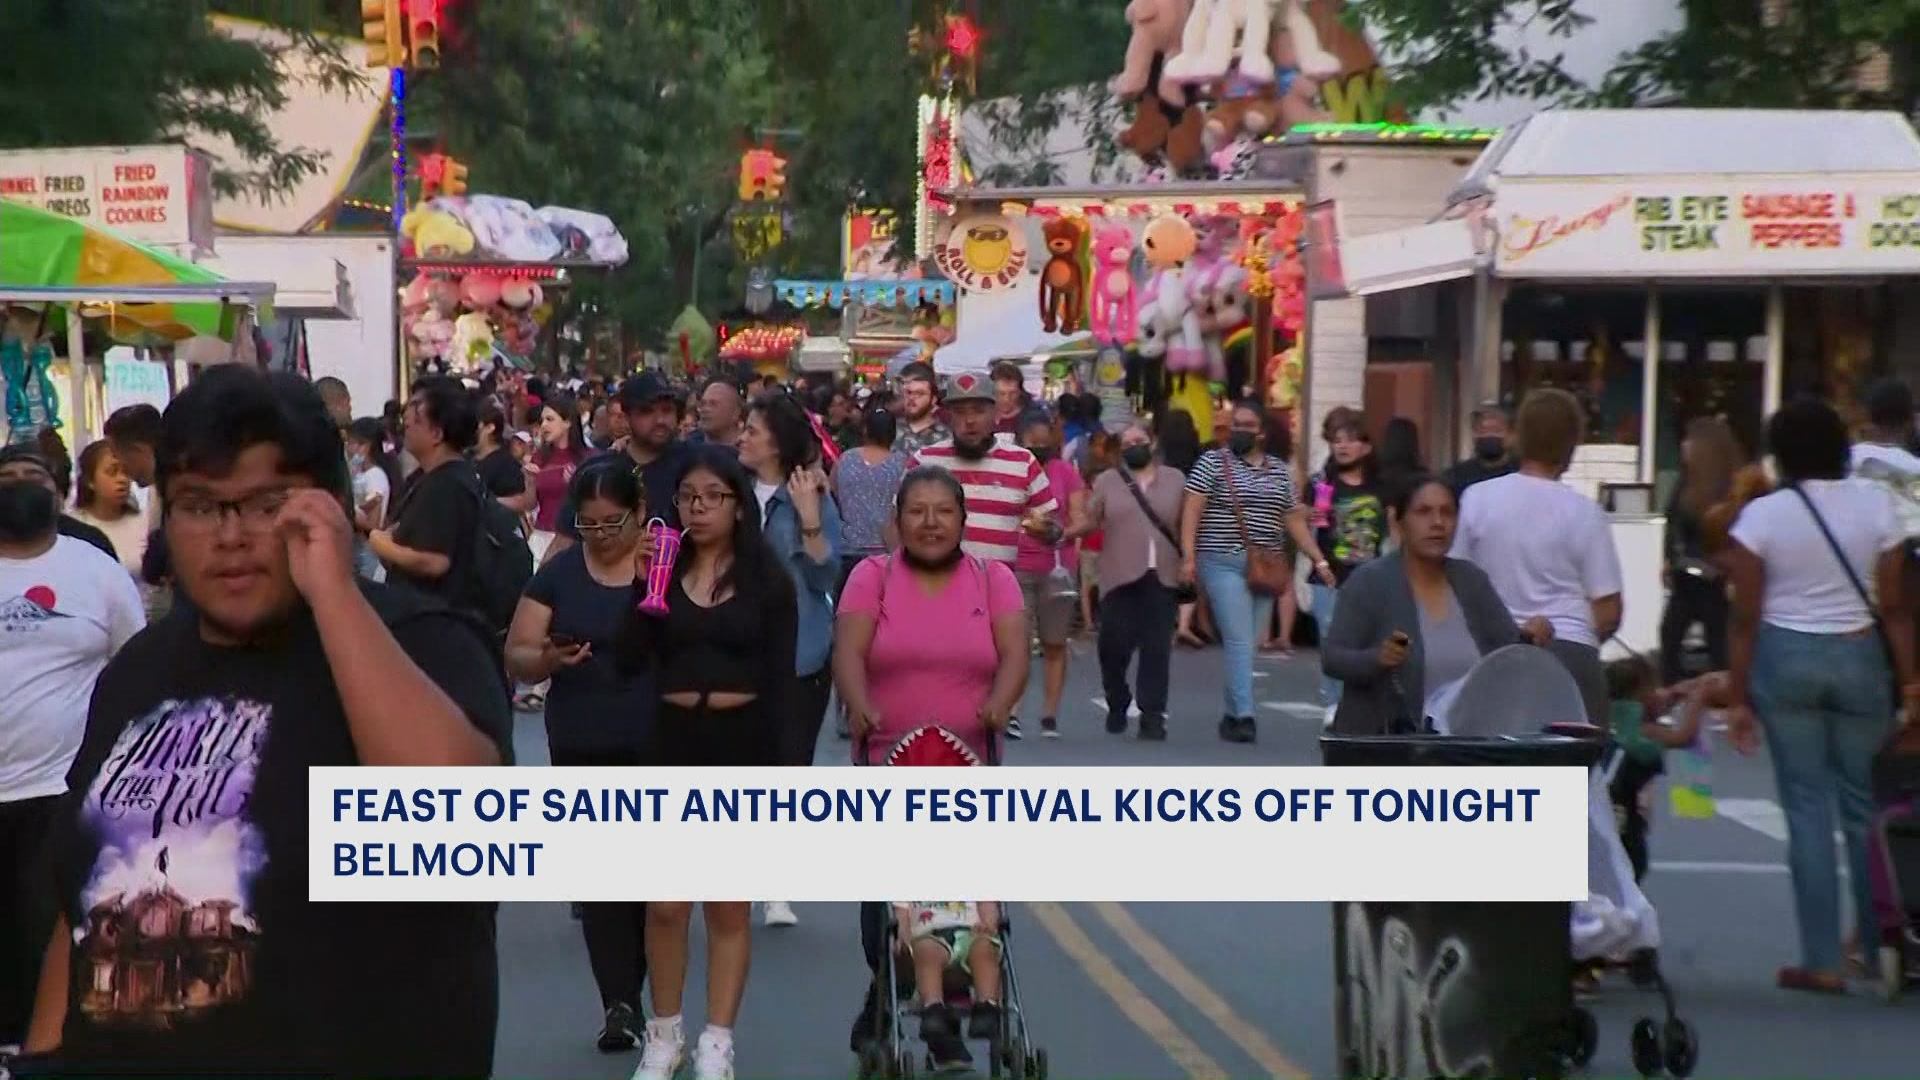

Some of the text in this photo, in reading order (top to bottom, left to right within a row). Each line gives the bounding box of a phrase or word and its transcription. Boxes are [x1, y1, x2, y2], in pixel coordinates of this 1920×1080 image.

[44, 176, 84, 192] FRIED
[115, 165, 156, 181] FRIED
[102, 186, 169, 203] RAINBOW
[1742, 192, 1835, 219] SAUSAGE
[46, 198, 91, 217] OREOS
[105, 206, 167, 225] COOKIES
[1635, 196, 1728, 221] RIB EYE
[1643, 224, 1719, 251] STEAK
[1750, 222, 1841, 248] PEPPERS
[948, 248, 974, 285] ROLL
[980, 276, 993, 290] A
[997, 250, 1026, 286] BALL
